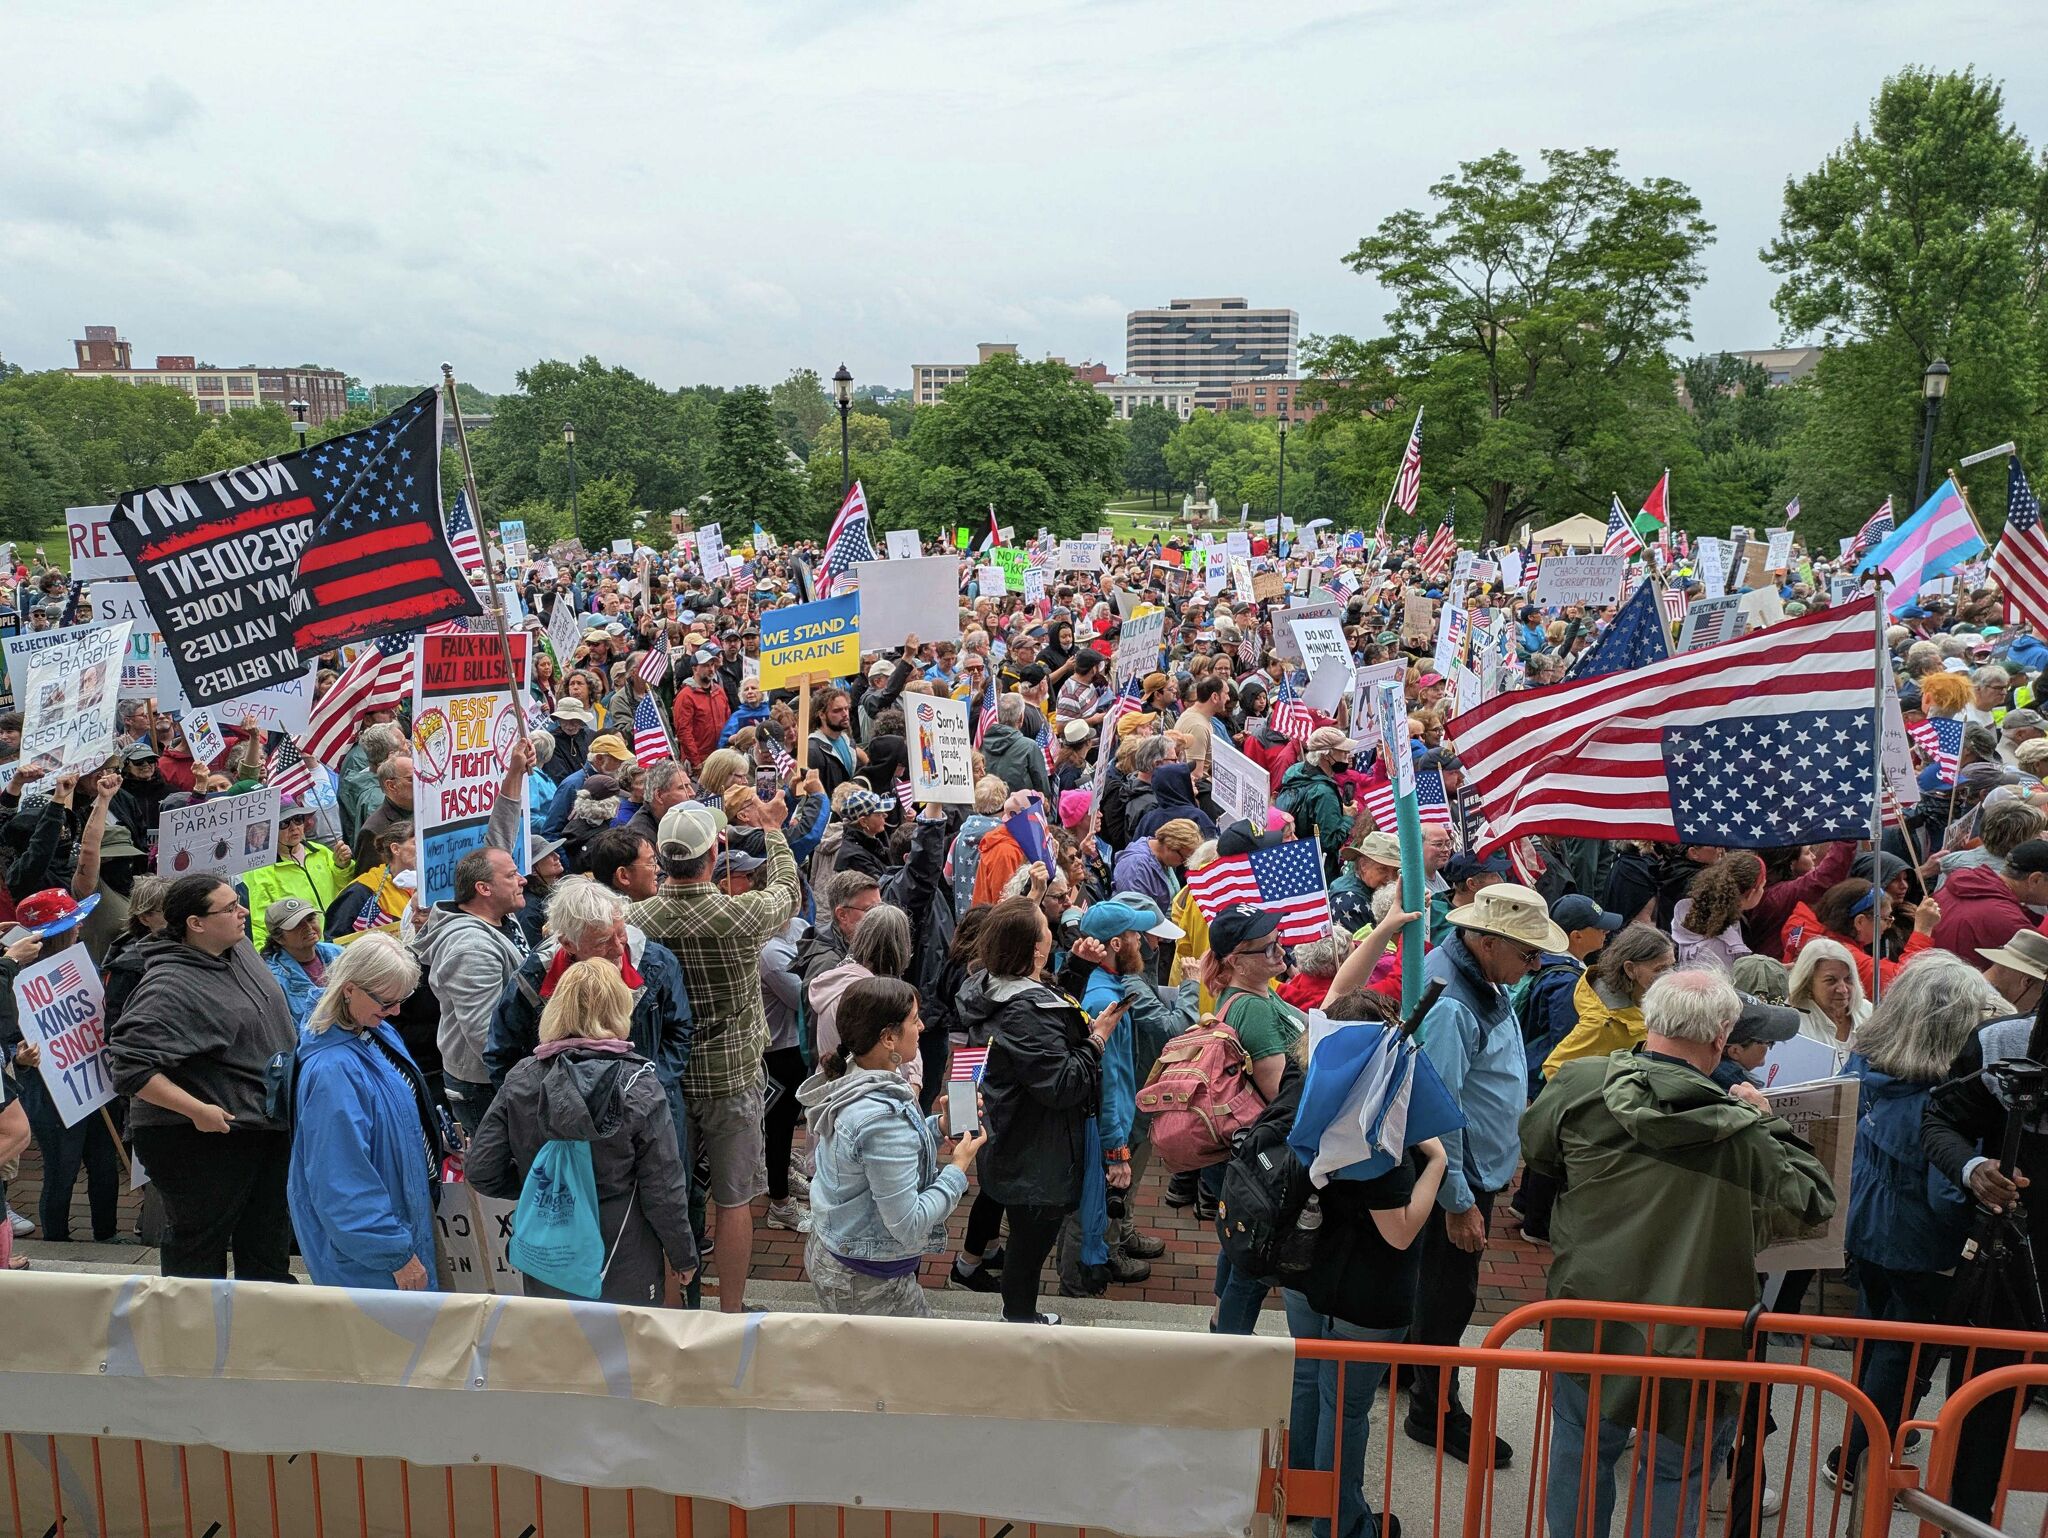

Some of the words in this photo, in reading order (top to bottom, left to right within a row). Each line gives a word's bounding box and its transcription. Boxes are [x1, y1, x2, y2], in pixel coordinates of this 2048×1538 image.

[68, 521, 123, 560] RE
[997, 551, 1011, 561] NO
[1071, 555, 1090, 563] EYES
[1211, 553, 1223, 564] NO
[1575, 556, 1595, 566] VOTE
[1601, 556, 1618, 566] FOR
[1209, 566, 1225, 578] KINGS
[1553, 567, 1577, 577] CHAOS
[1555, 577, 1612, 587] CORRUPTION?
[1556, 592, 1580, 604] JOIN
[1585, 591, 1603, 604] US!
[1689, 600, 1720, 615] REJECTING
[1720, 599, 1737, 609] KINGS
[1297, 608, 1333, 619] AMERICA
[763, 628, 789, 647] WE
[793, 617, 845, 641] STAND
[850, 614, 860, 628] 4
[1122, 621, 1137, 639] RULE
[1139, 616, 1148, 634] OF
[1304, 630, 1318, 641] DO
[1320, 629, 1335, 640] NOT
[10, 633, 68, 654] REJECTING
[29, 629, 112, 669] GESTAPO
[441, 637, 511, 657] FAUX-KIN
[771, 640, 845, 667] UKRAINE
[1306, 642, 1344, 653] MINIMIZE
[59, 639, 120, 677] BARBIE
[425, 662, 457, 684] NAZI
[222, 700, 278, 721] GREAT
[449, 696, 498, 722] RESIST
[22, 708, 100, 751] GESTAPO
[188, 711, 209, 732] YES
[936, 710, 955, 732] Sorry
[956, 714, 964, 729] to
[77, 718, 108, 747] KEN
[456, 720, 489, 750] EVIL
[939, 733, 950, 746] rain
[950, 736, 956, 746] on
[957, 737, 967, 748] your
[200, 741, 221, 763] RIGHTS
[940, 748, 961, 763] parade,
[451, 751, 494, 780] FIGHT
[943, 761, 970, 786] Donnie!
[170, 802, 217, 822] KNOW
[228, 790, 272, 808] YOUR
[175, 802, 266, 836] PARASITES
[426, 838, 444, 857] When
[21, 975, 54, 1012] NO
[34, 988, 96, 1040] KINGS
[49, 1016, 107, 1070] SINCE
